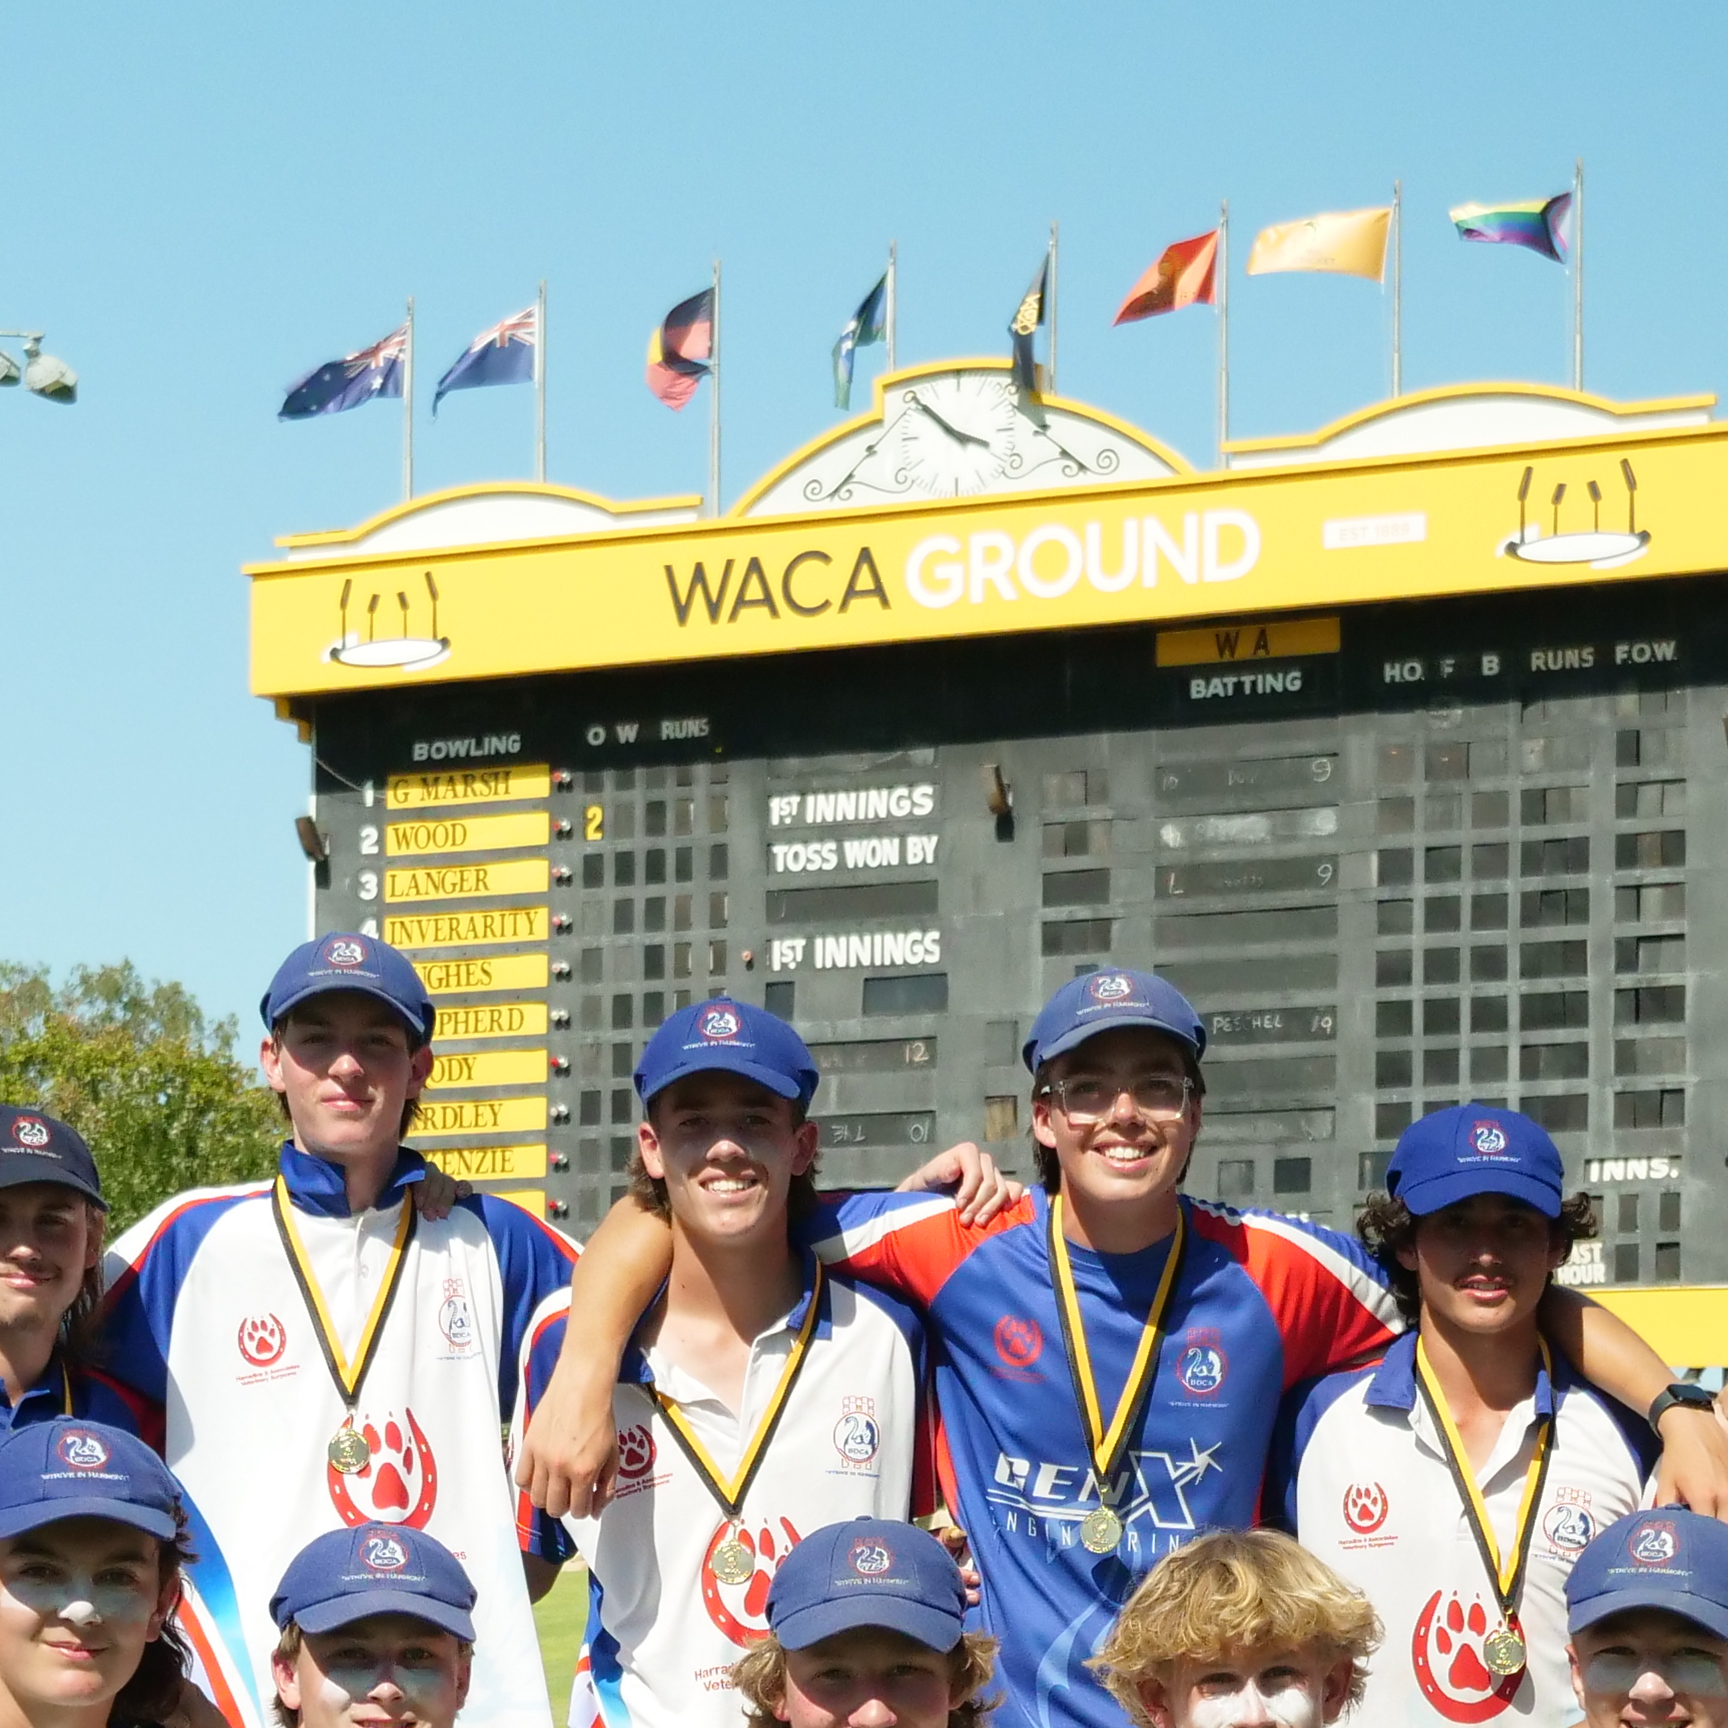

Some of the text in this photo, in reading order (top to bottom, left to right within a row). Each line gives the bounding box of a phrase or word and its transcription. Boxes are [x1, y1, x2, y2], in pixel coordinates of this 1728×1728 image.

[663, 508, 1262, 628] WACA GROUND
[1482, 655, 1500, 677] B
[1530, 646, 1595, 672] RUNS
[1189, 671, 1303, 701] BATTING
[412, 734, 522, 762] BOWLING
[616, 723, 640, 745] W
[660, 717, 710, 741] RUNS
[392, 780, 411, 805] G
[418, 769, 513, 802] MARSH
[806, 785, 935, 825] INNINGS
[359, 805, 604, 856] 2 WOOD 2
[771, 834, 940, 874] TOSS WON BY
[357, 867, 491, 901] 3 LANGER
[388, 909, 541, 945] INVERARITY
[813, 930, 942, 970] INNINGS
[434, 1007, 525, 1036] PHERD
[1560, 1241, 1603, 1265] AST
[1556, 1263, 1607, 1286] HOUR
